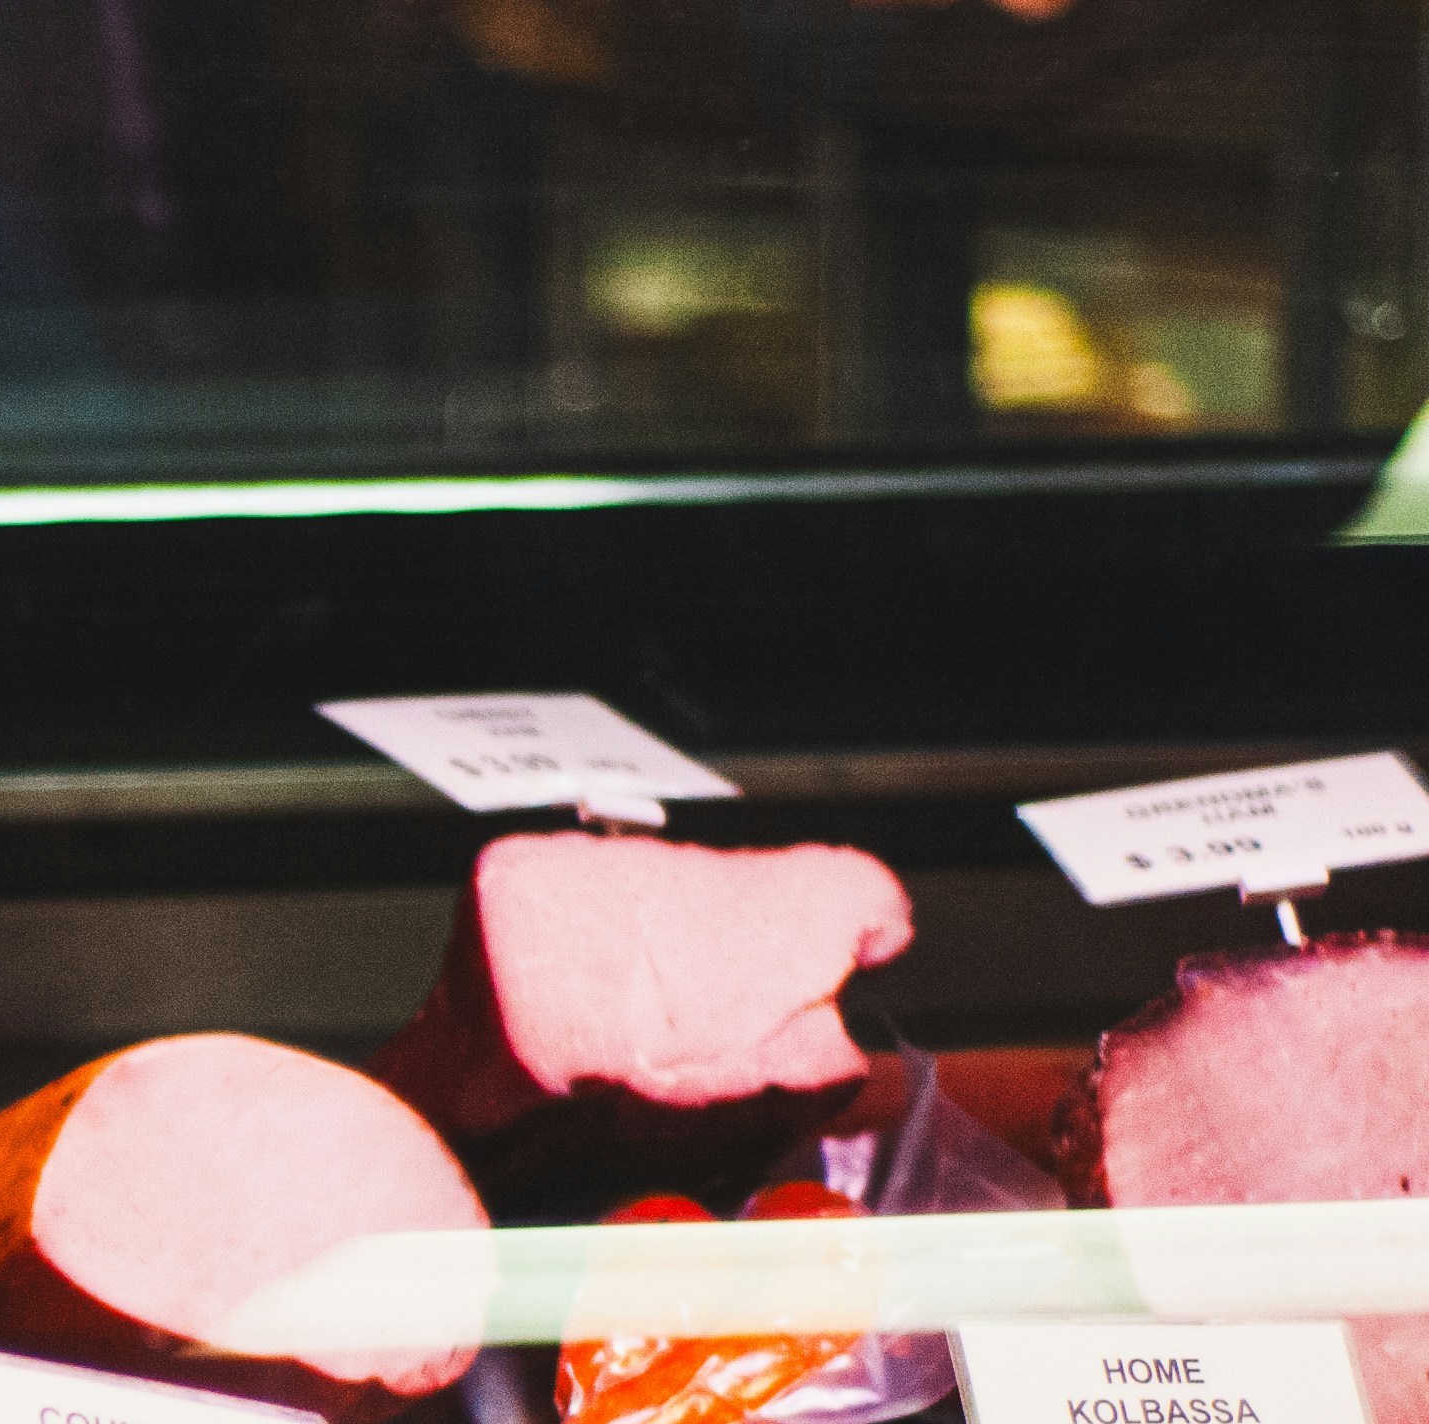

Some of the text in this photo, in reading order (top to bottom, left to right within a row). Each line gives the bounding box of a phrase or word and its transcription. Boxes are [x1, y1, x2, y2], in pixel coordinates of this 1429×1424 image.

[1125, 851, 1152, 870] $
[1167, 837, 1262, 863] 3.99
[1102, 1357, 1206, 1385] HOME
